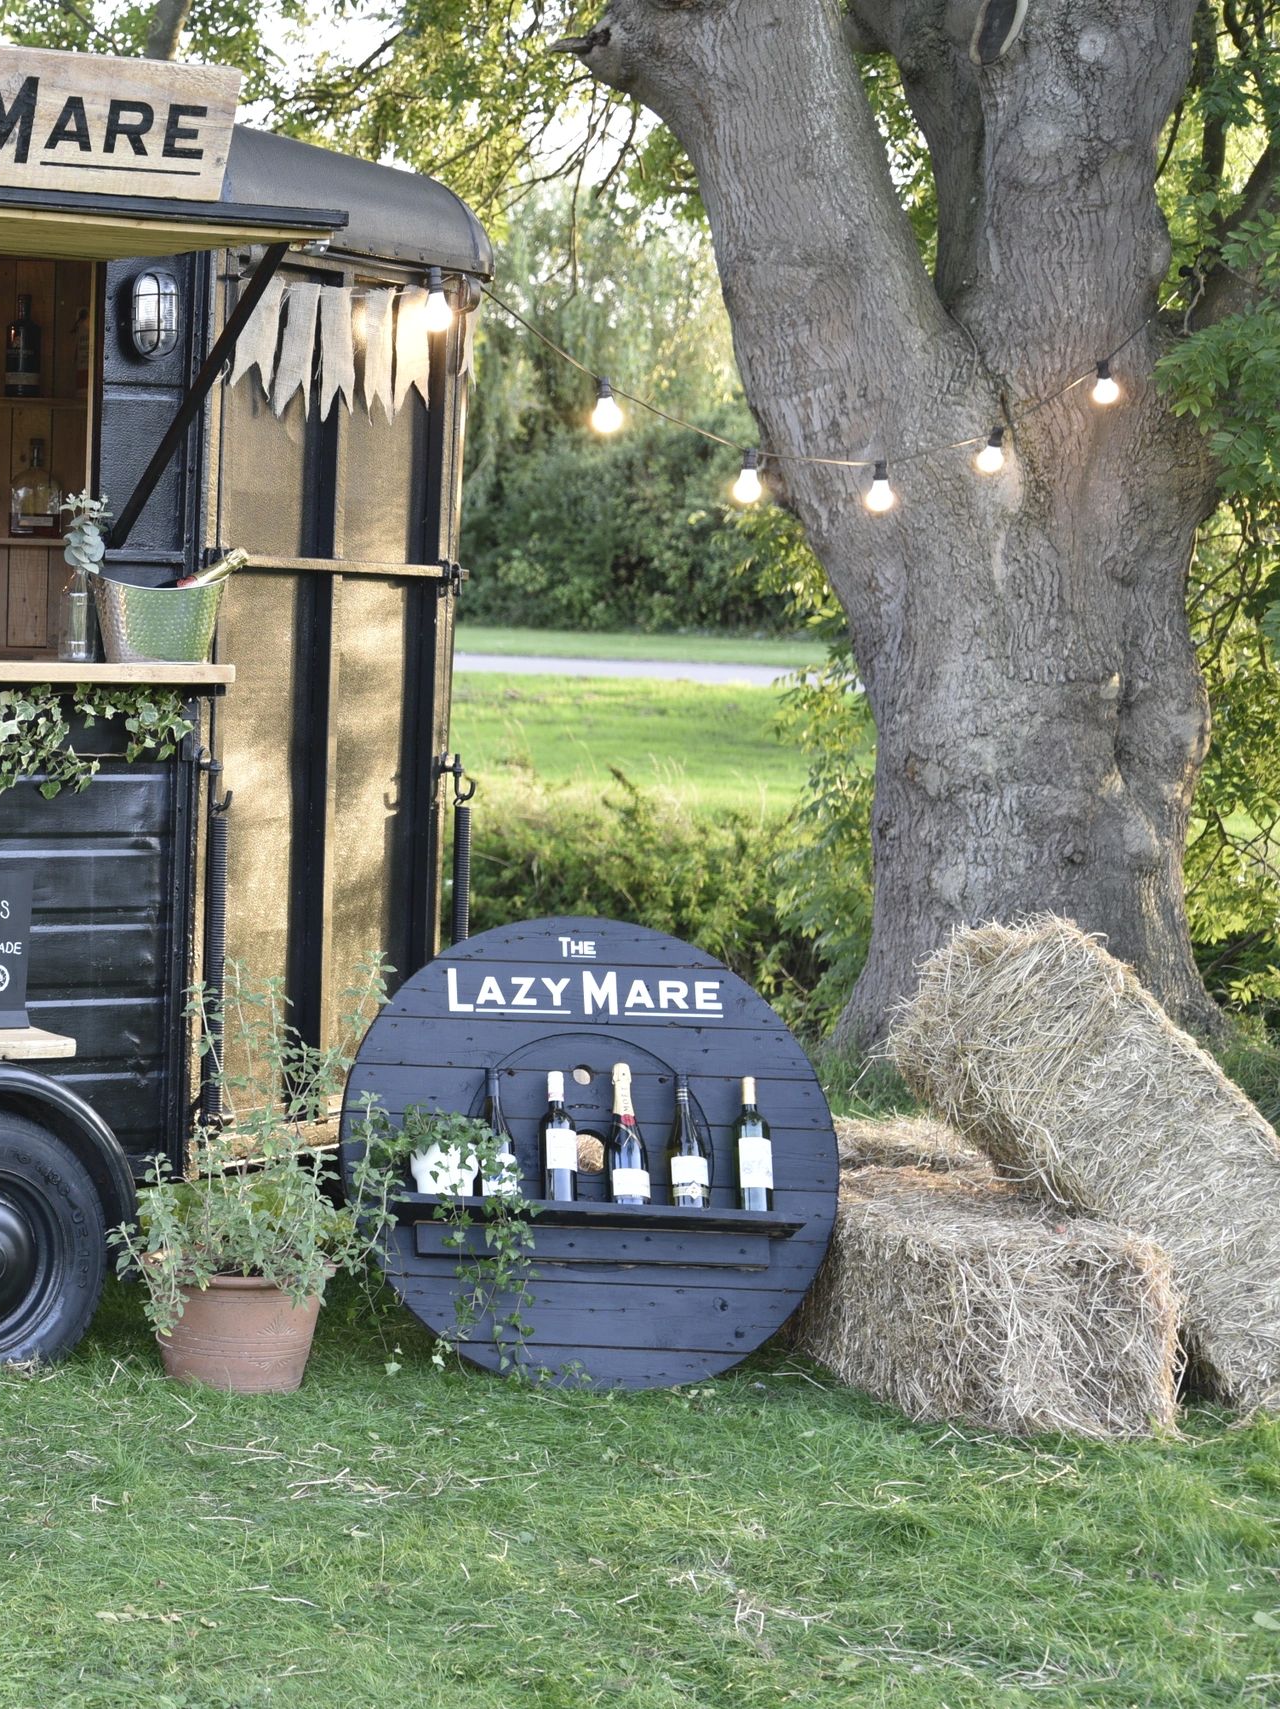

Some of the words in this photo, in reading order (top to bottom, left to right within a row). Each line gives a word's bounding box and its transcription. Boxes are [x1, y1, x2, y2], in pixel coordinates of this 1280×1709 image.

[558, 936, 597, 958] THE
[447, 967, 571, 1013] LAZY
[582, 970, 724, 1016] MARE
